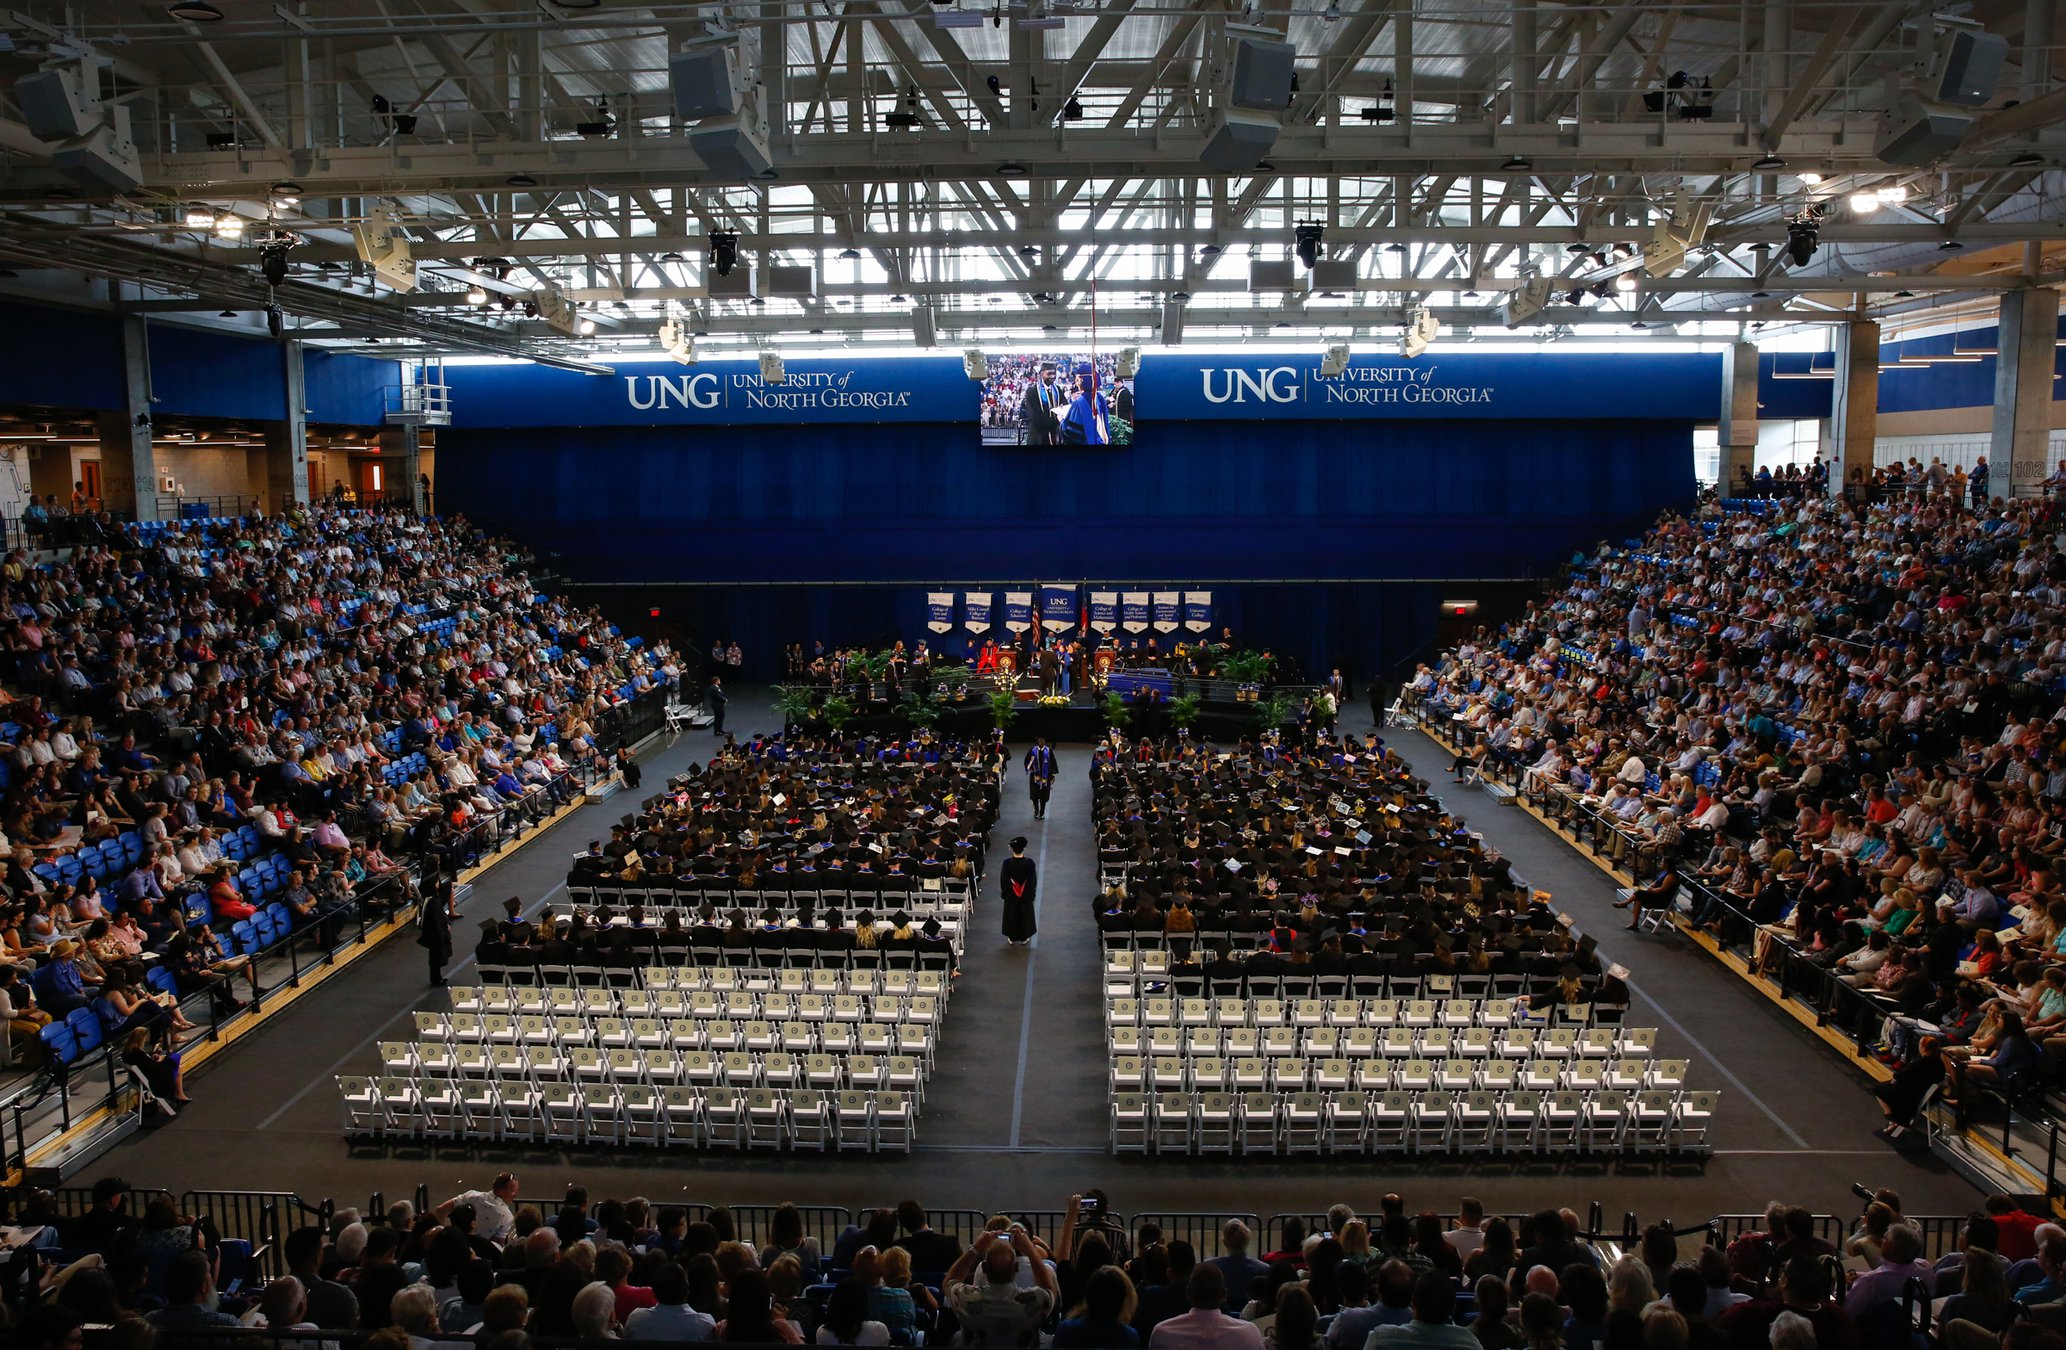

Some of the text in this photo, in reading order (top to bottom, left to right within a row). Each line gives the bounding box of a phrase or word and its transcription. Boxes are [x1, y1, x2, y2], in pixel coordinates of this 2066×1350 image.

[732, 370, 855, 390] UNIERSITY of
[1200, 366, 1300, 403] UNG
[1420, 365, 1438, 386] of
[624, 373, 721, 410] UNG
[746, 389, 818, 411] NORTH
[1325, 383, 1400, 406] NORTH
[1990, 461, 2010, 479] 102
[2014, 460, 2046, 479] 102
[1050, 597, 1068, 606] UNG
